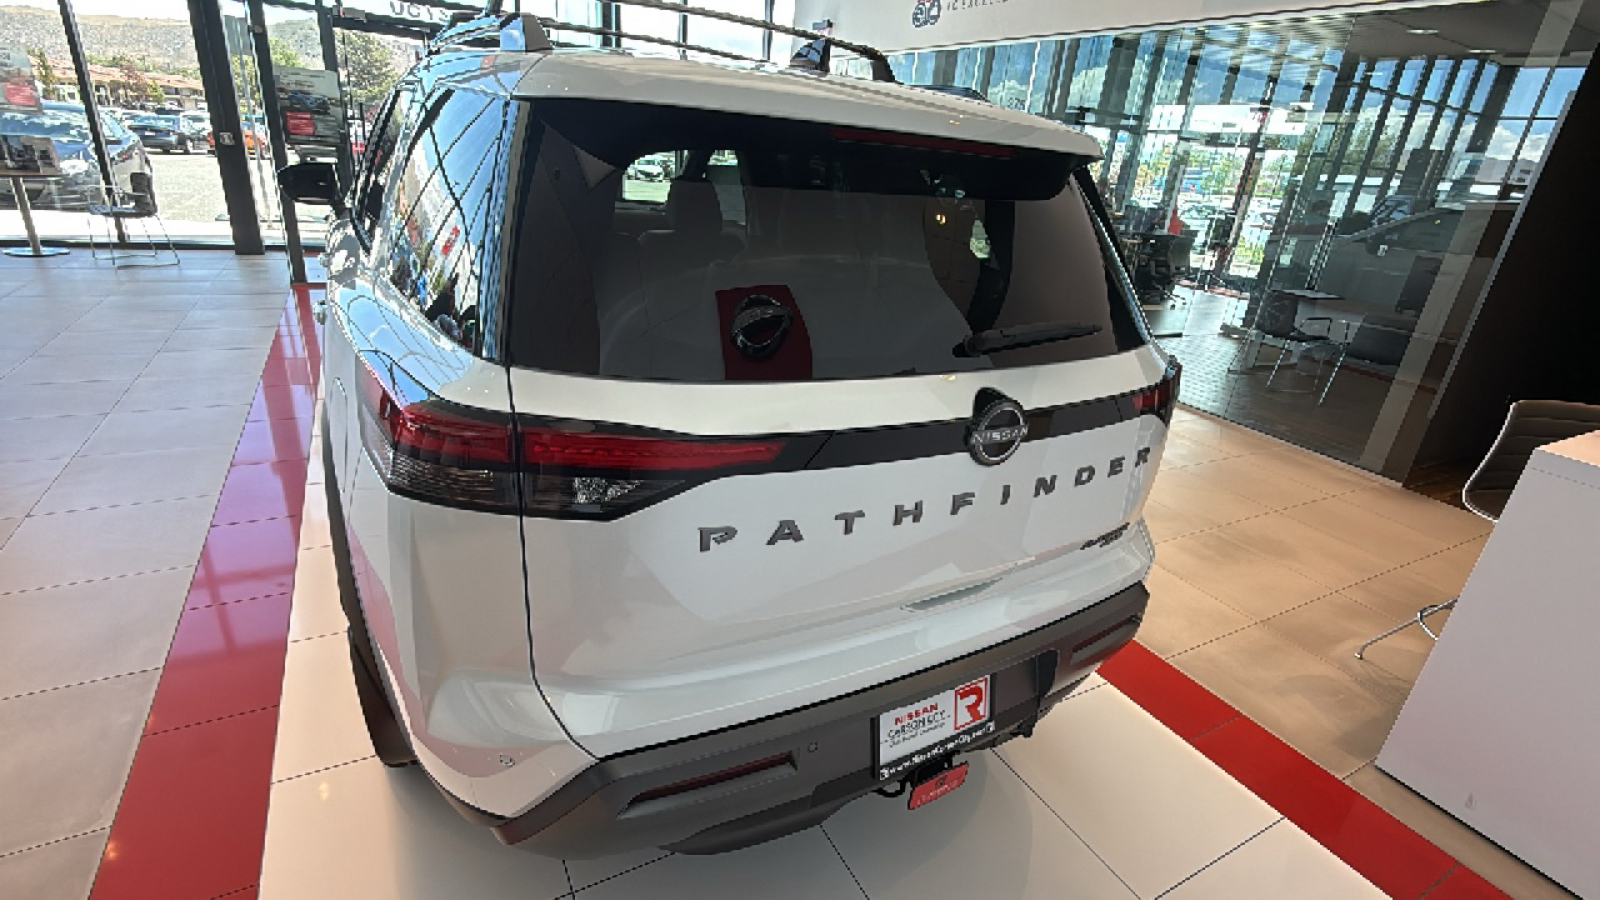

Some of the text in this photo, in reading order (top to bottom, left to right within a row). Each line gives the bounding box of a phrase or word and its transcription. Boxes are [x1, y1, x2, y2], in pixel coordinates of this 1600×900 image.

[973, 425, 1029, 444] NISSAN
[698, 446, 1152, 552] PATHFINDER
[894, 702, 939, 726] NISSAN
[888, 716, 926, 741] CARSON
